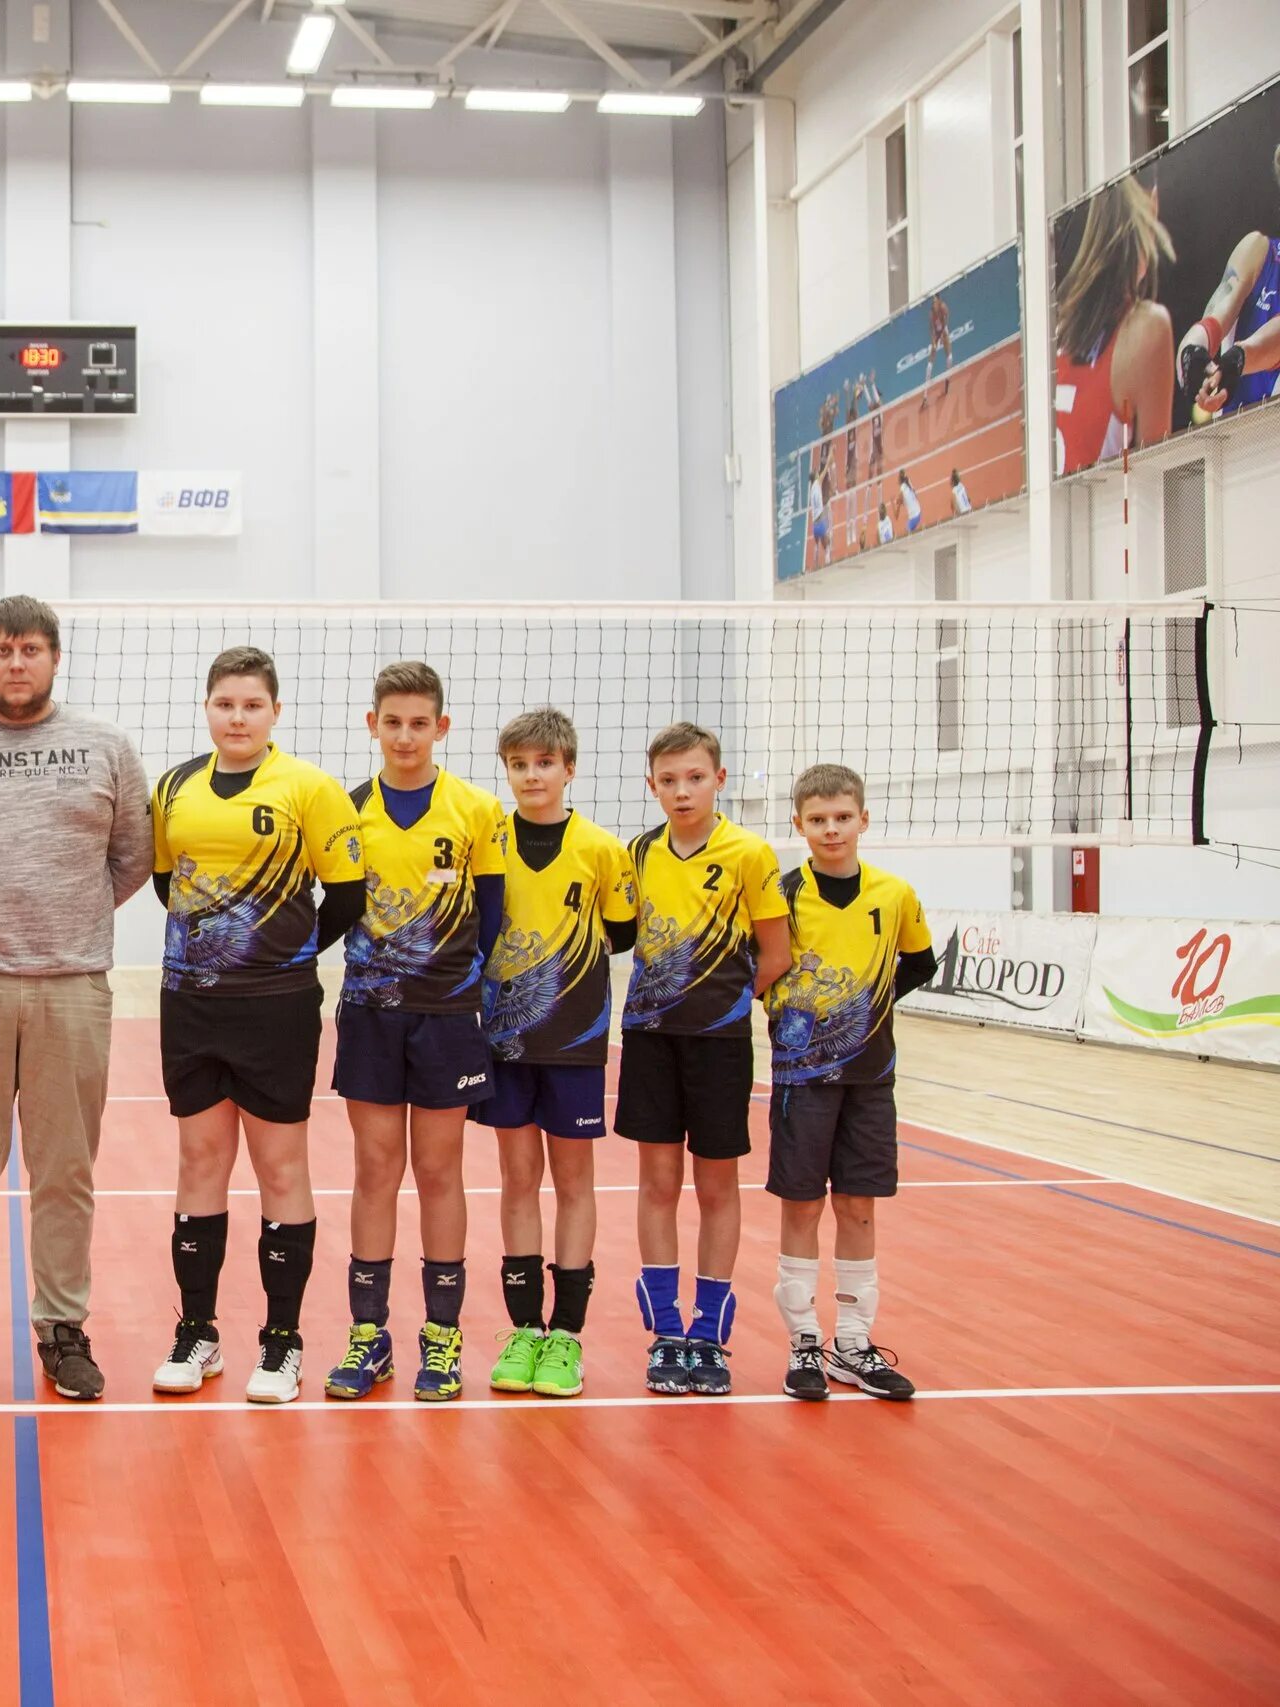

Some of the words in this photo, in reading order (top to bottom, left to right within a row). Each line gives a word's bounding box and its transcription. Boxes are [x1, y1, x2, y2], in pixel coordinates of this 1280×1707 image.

[178, 489, 229, 508] ВФВ
[252, 805, 274, 836] 6
[433, 837, 454, 869] 3
[702, 863, 723, 892] 2
[563, 881, 581, 912] 4
[868, 908, 882, 935] 1
[962, 926, 1000, 956] Cafe
[1171, 928, 1231, 1007] 10
